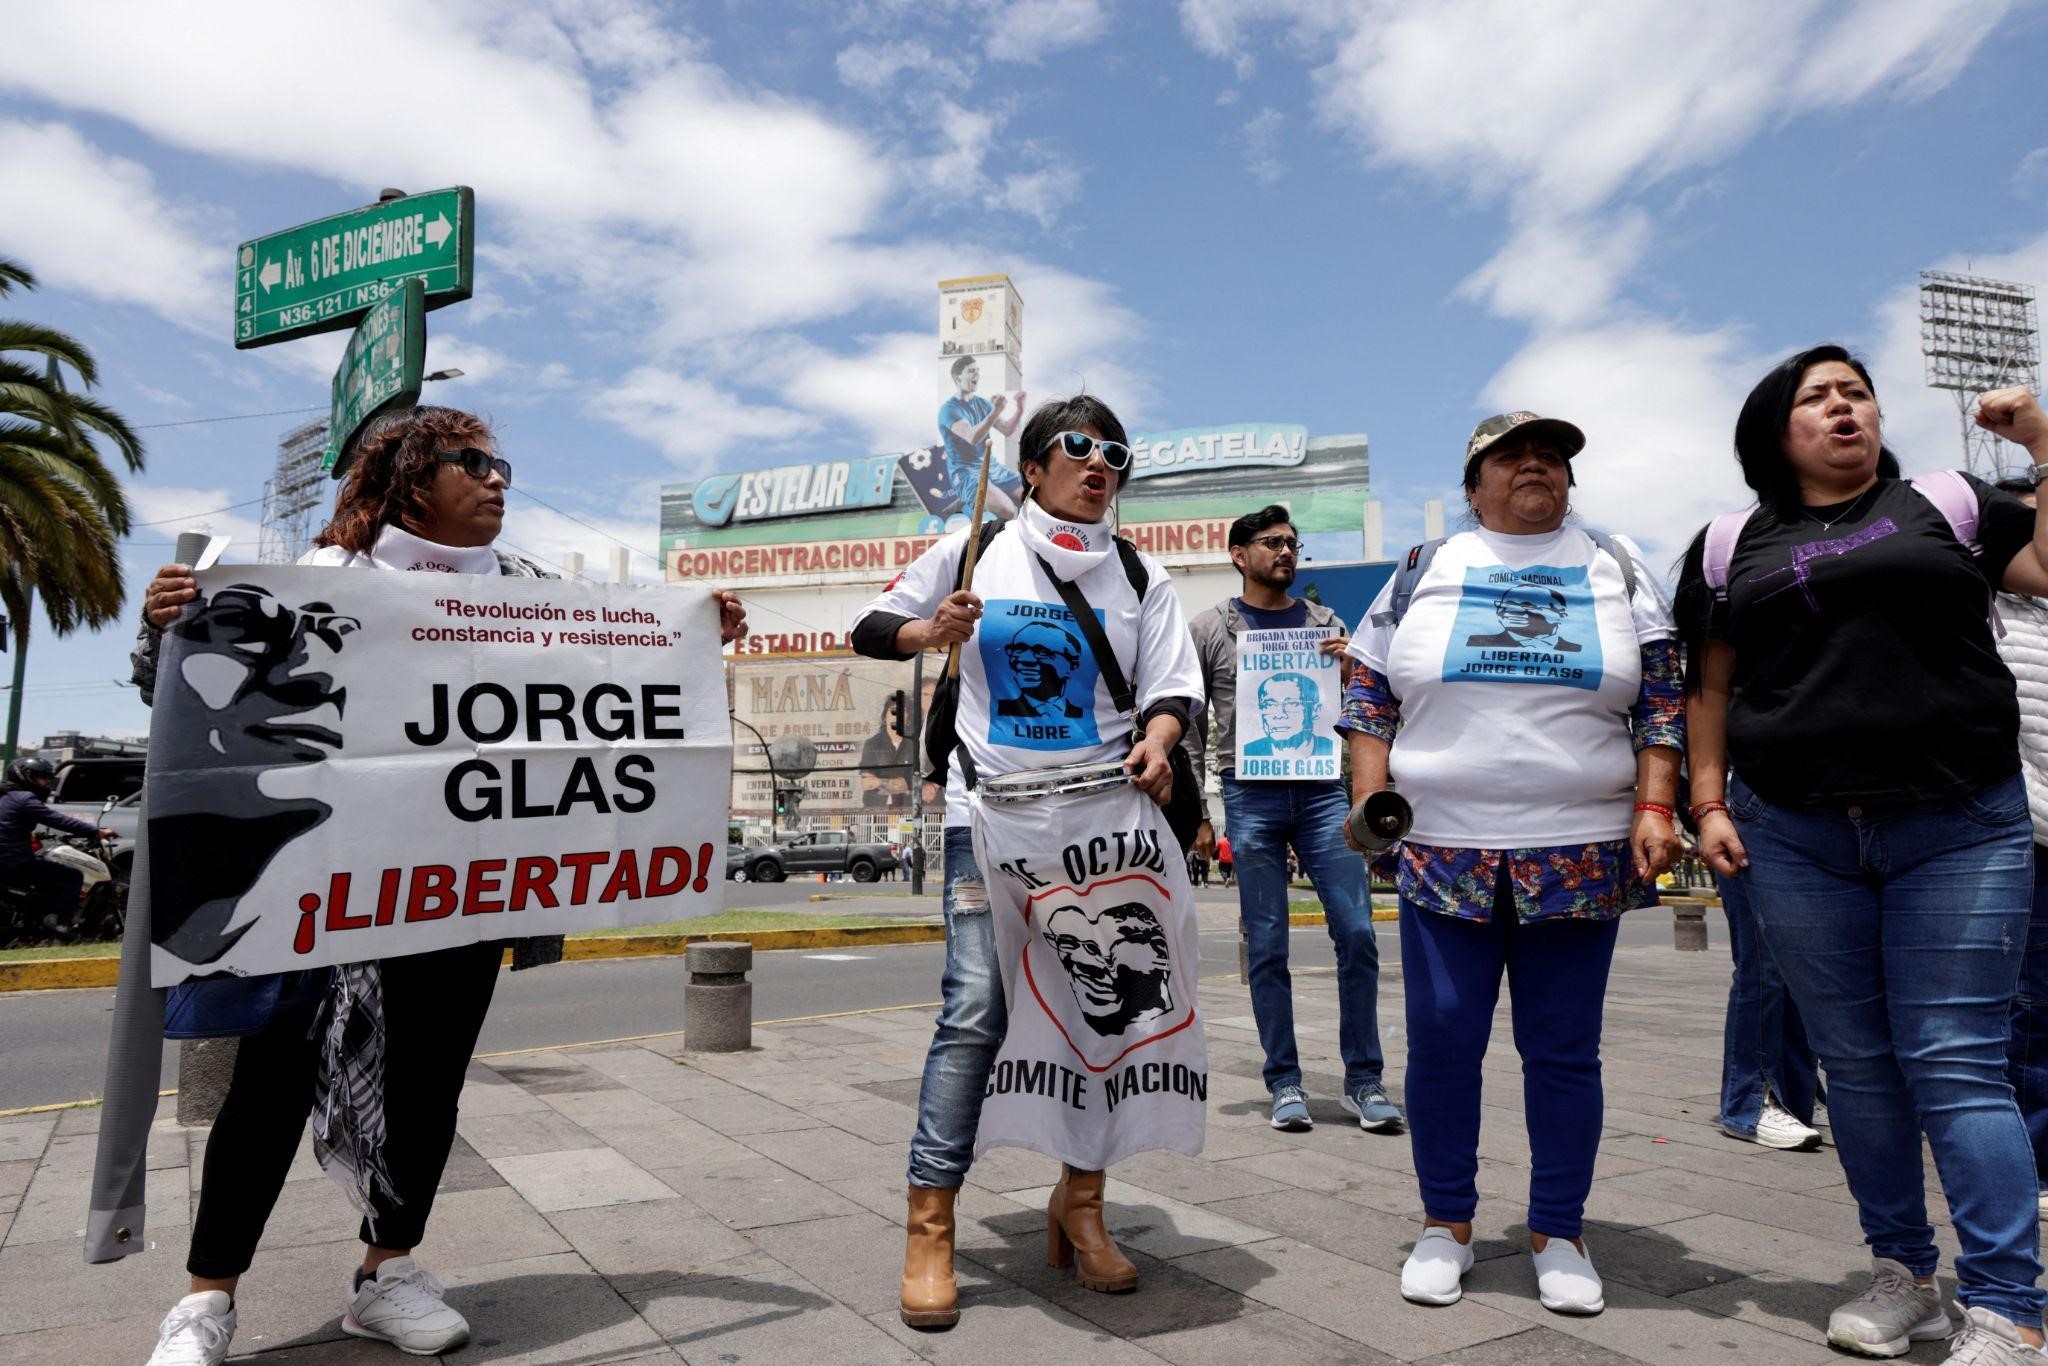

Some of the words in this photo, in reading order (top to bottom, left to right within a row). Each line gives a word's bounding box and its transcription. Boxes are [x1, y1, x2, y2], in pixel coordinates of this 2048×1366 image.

[310, 242, 319, 282] 6
[322, 236, 340, 279] DE
[343, 213, 424, 272] DICIEMBRE
[240, 298, 252, 313] 4
[279, 296, 342, 327] N36-121
[240, 321, 252, 337] 3
[677, 542, 886, 577] CONCENTRACION
[572, 608, 597, 623] es
[602, 606, 662, 628] lucha,
[1006, 604, 1076, 622] JORGE
[411, 623, 535, 644] constancia
[541, 631, 553, 648] y
[734, 631, 836, 655] ESTADIO
[1246, 631, 1286, 643] BRIGADA
[1262, 641, 1289, 653] JORGE
[1292, 641, 1315, 651] GLAS
[1243, 652, 1335, 671] LIBERTAD
[1480, 650, 1565, 664] LIBERTAD
[1460, 662, 1517, 675] JORGE
[1523, 664, 1584, 680] GLASS
[404, 682, 685, 747] JORGE
[1013, 723, 1072, 740] LIBRE
[1242, 759, 1290, 777] JORGE
[1294, 758, 1335, 776] GLAS
[444, 754, 657, 823] GLAS
[811, 779, 837, 788] VENTA
[838, 778, 850, 788] EN
[293, 842, 714, 954] ¡LIBERTAD!
[1104, 1062, 1208, 1113] NACION
